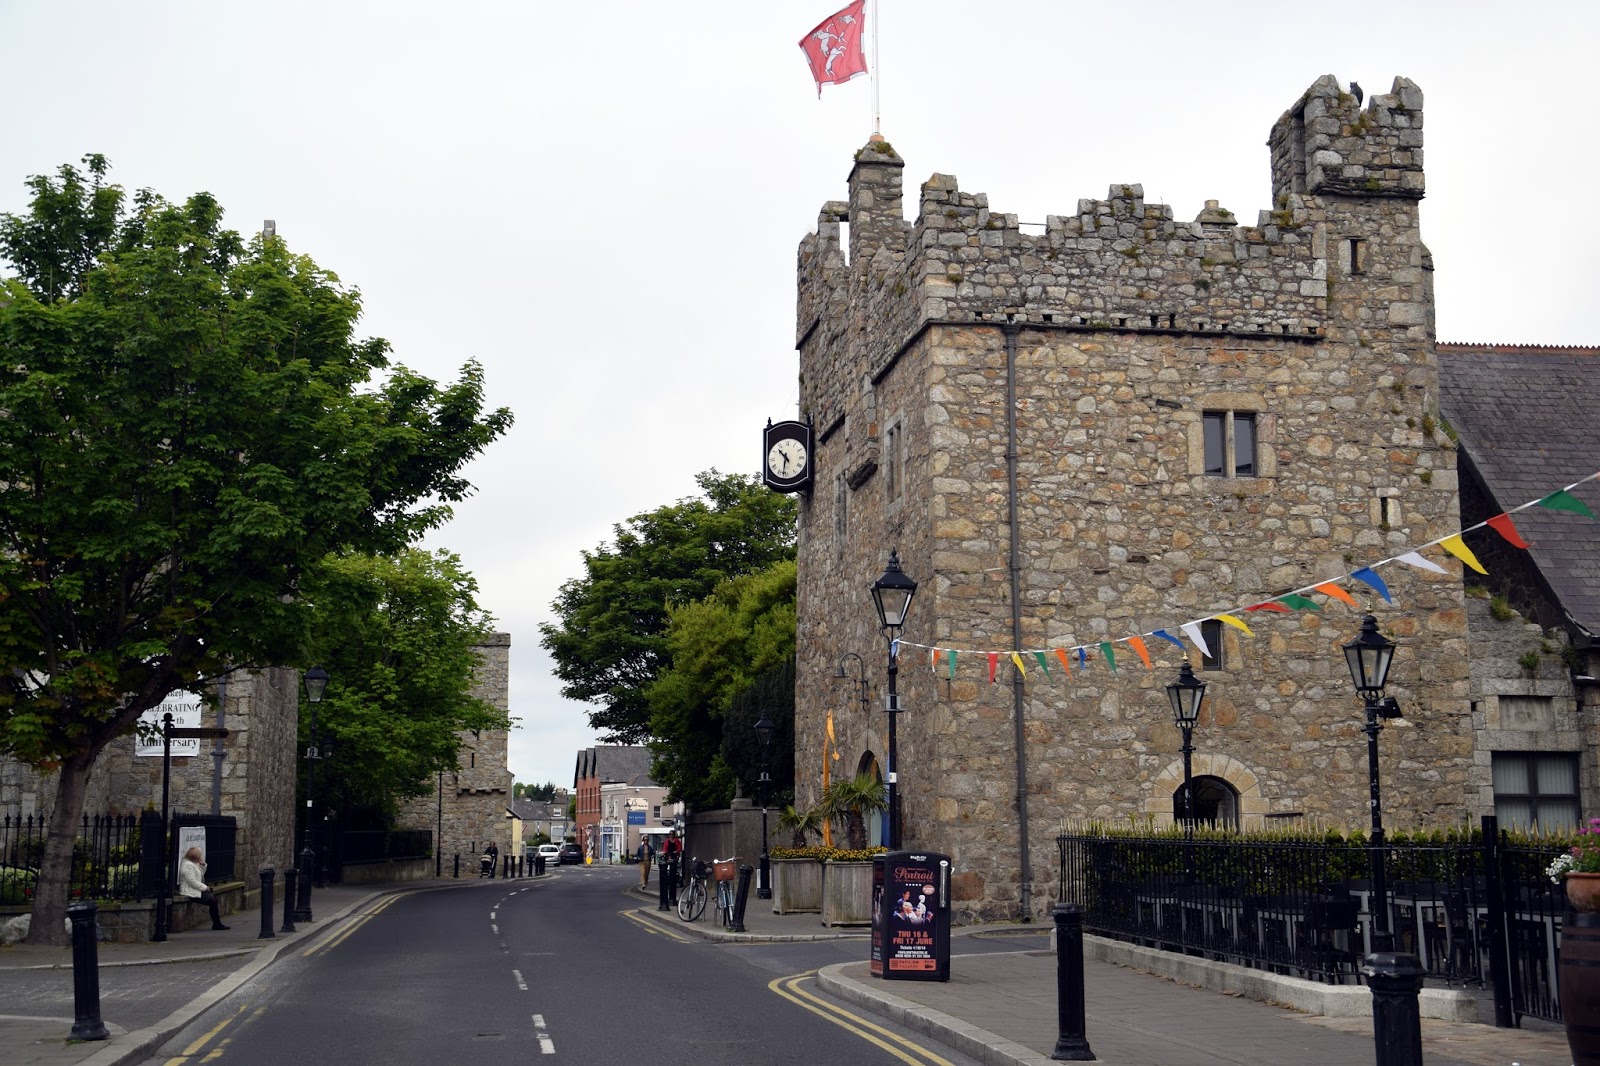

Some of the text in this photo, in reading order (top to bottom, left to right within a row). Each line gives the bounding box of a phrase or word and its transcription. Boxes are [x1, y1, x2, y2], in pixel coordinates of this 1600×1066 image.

[146, 703, 198, 712] ELEBRATING
[895, 867, 935, 880] Portrait
[893, 937, 933, 945] FRI 17 JUNE
